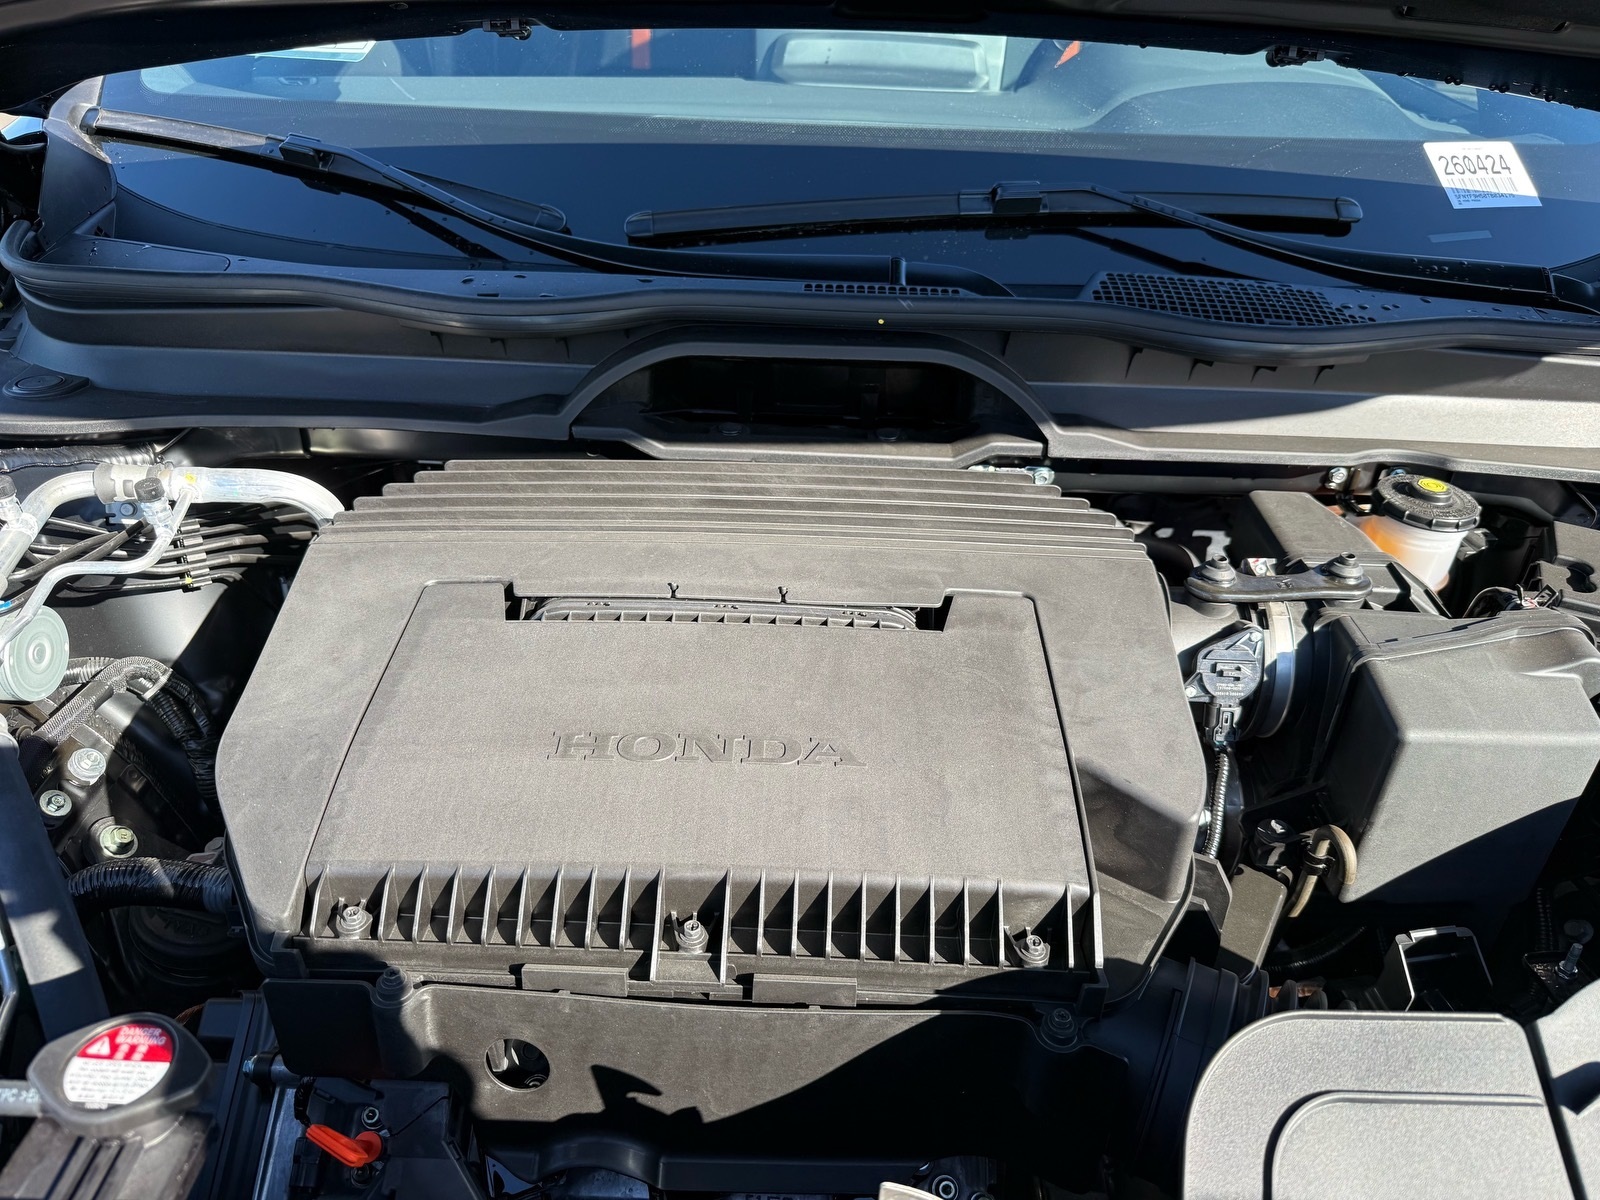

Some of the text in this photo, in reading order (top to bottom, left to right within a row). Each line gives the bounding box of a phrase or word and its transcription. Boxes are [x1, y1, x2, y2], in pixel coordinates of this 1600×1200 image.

[1438, 154, 1512, 176] 260424
[546, 731, 868, 768] HONDA
[120, 1025, 162, 1037] DANGER
[115, 1034, 167, 1046] WARNING
